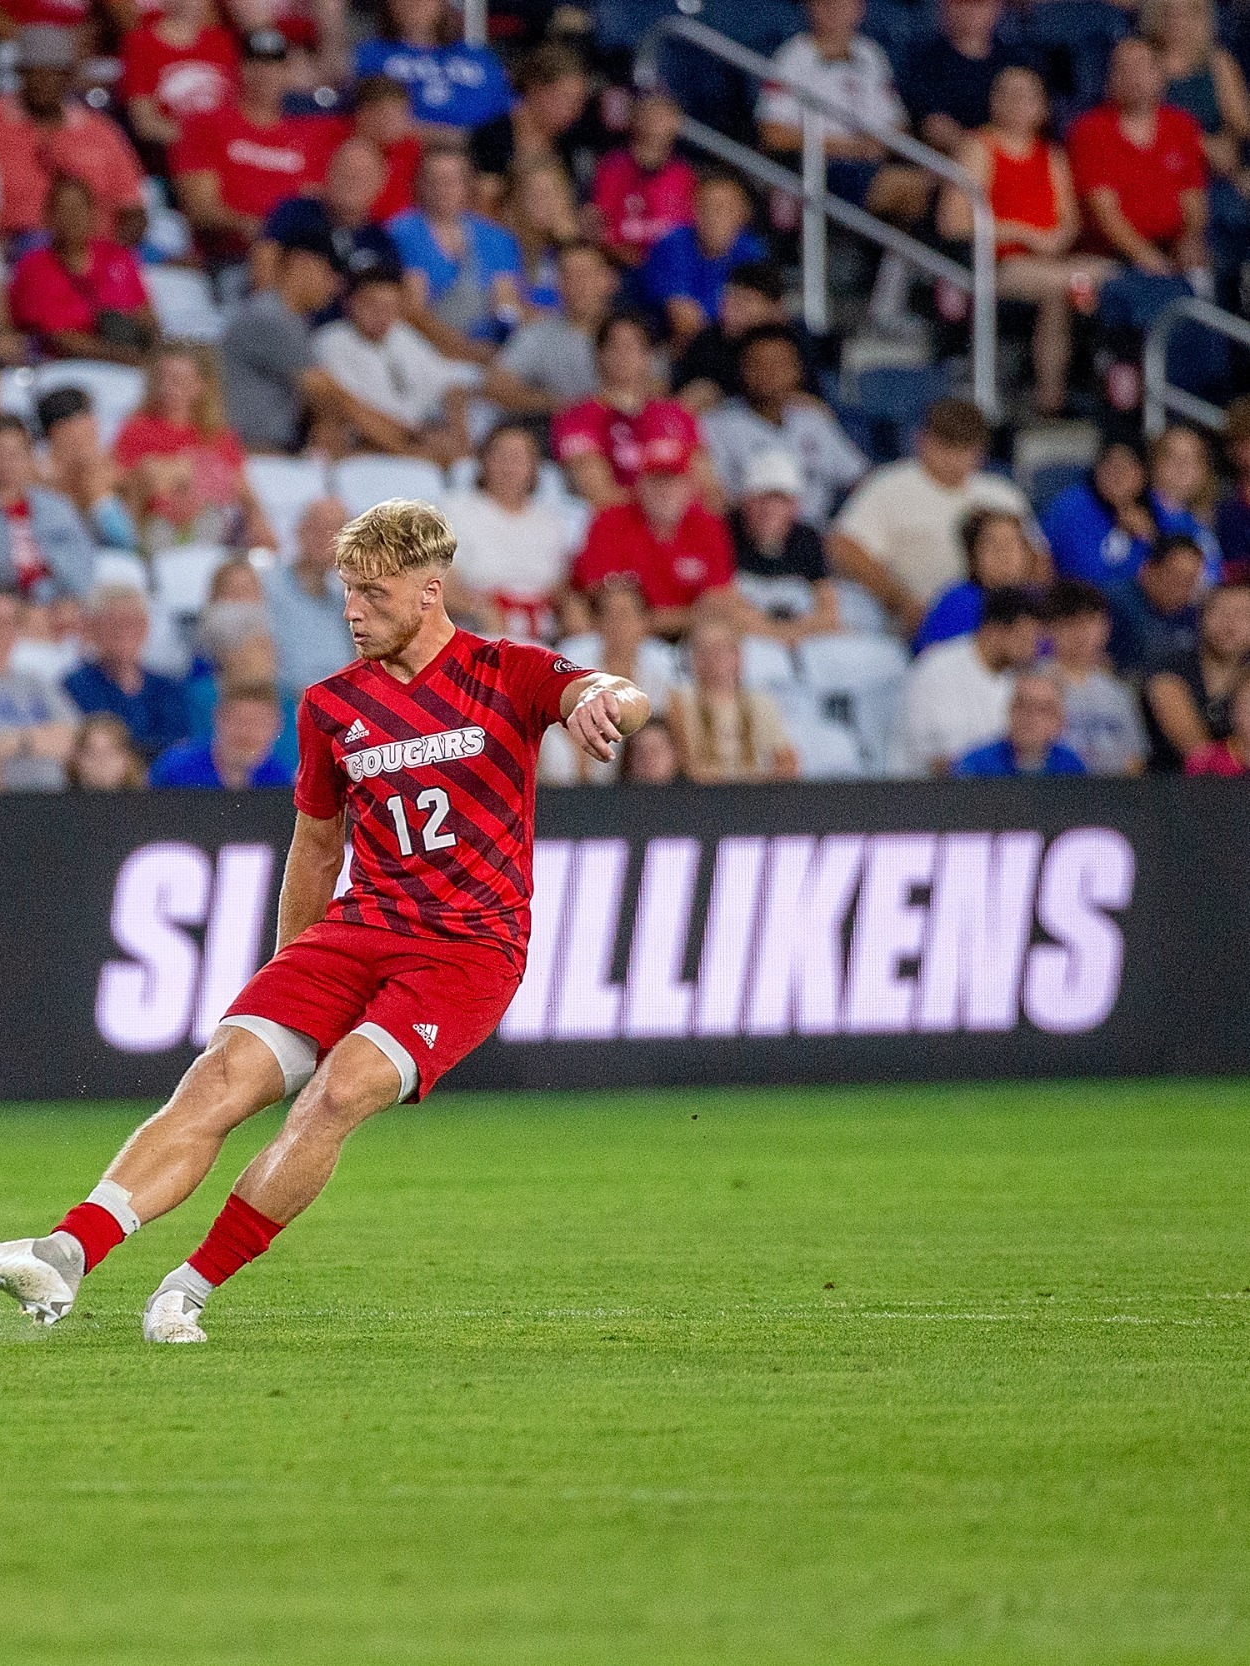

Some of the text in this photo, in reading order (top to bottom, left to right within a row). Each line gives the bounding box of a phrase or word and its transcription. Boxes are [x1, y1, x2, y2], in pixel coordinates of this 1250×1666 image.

[342, 726, 485, 782] COUGARS
[345, 729, 369, 743] adidas
[387, 788, 456, 856] 12
[498, 825, 1135, 1041] ILLIKENS
